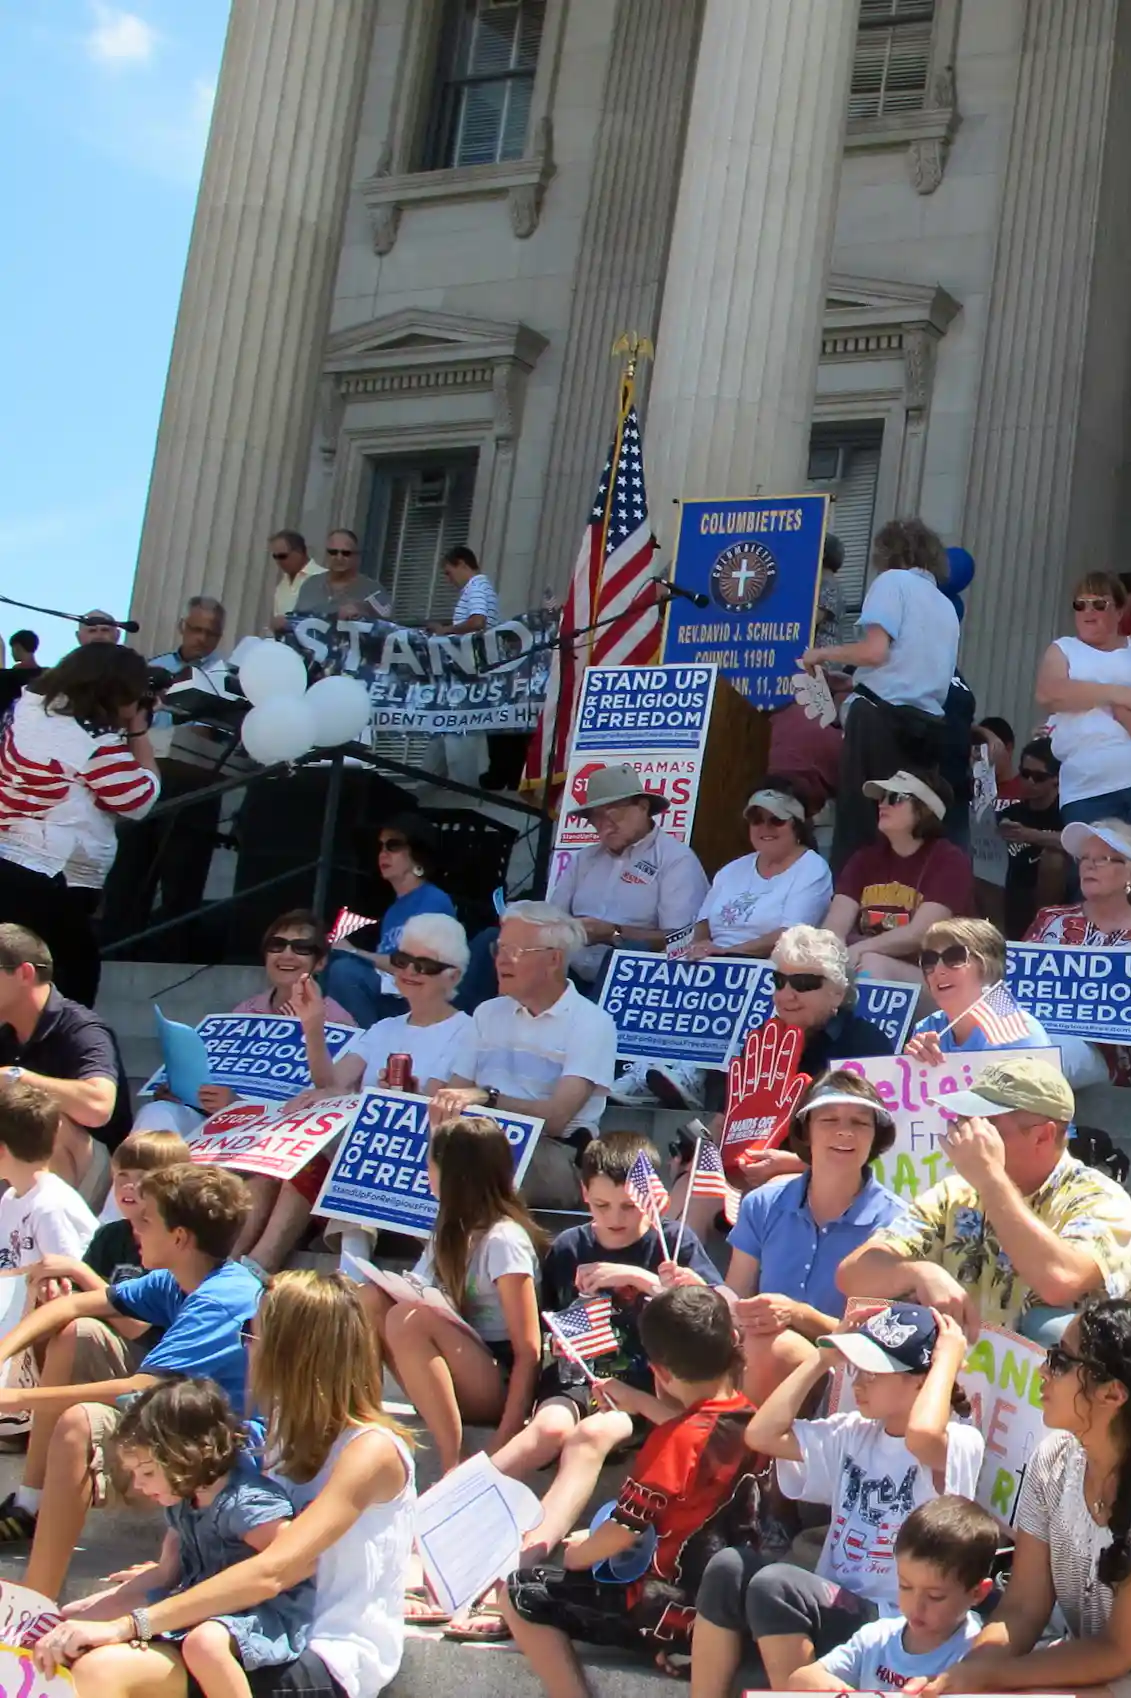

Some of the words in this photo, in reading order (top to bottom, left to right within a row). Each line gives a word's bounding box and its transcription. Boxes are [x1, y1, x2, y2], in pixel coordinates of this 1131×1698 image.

[700, 508, 803, 535] COLUMBIETTES
[747, 622, 800, 642] SCHILLER
[294, 617, 534, 678] STAND
[743, 649, 775, 668] 11910
[366, 677, 508, 706] ELIGIOUS
[588, 671, 668, 692] STAND
[675, 670, 708, 690] UP
[582, 695, 598, 729] FOR
[599, 692, 704, 710] RELIGIOUS
[432, 709, 508, 728] OBAMA'S
[514, 706, 538, 722] HH
[596, 711, 702, 728] FREEDOM
[623, 761, 696, 774] BAMA'S
[574, 778, 589, 792] ST
[616, 958, 717, 988] STAND
[1006, 950, 1113, 979] STAND
[607, 985, 628, 1014] OR
[628, 987, 745, 1014] RELIGIOU
[867, 989, 907, 1014] UP
[199, 1019, 296, 1040] STAND
[621, 1009, 732, 1036] FREEDO
[205, 1039, 309, 1063] RELIGIOU
[208, 1056, 312, 1084] REEDOM
[211, 1114, 257, 1125] STOP
[241, 1111, 345, 1137] HHS
[337, 1131, 370, 1179] FOR
[356, 1159, 431, 1194] FREE
